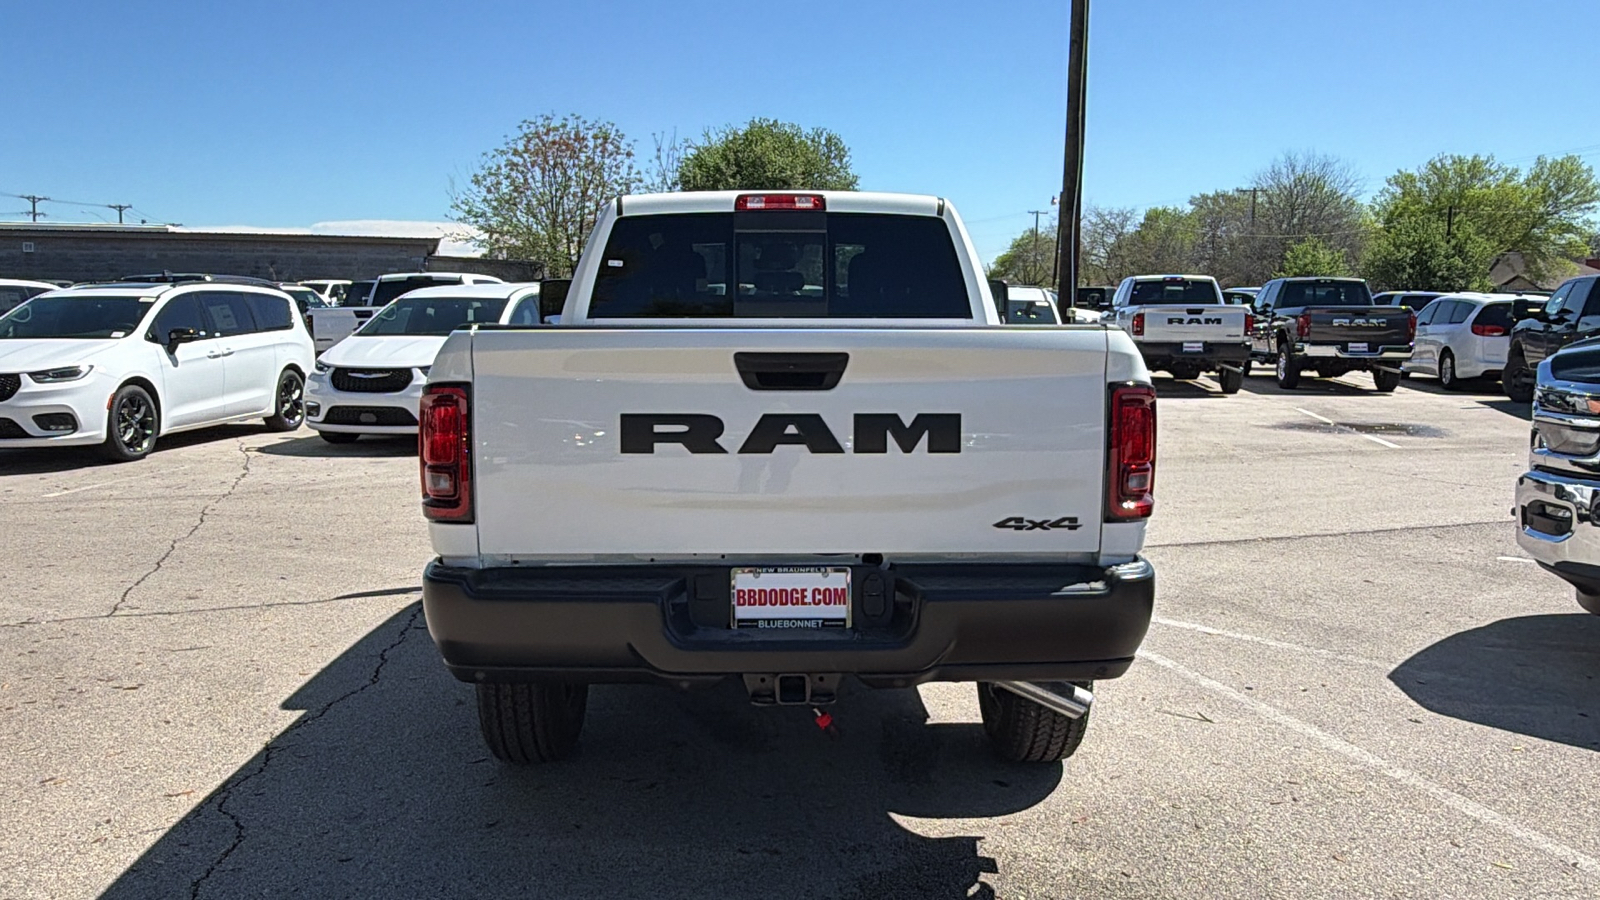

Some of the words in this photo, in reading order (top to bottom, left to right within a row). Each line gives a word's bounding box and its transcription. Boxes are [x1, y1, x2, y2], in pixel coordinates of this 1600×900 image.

[1167, 317, 1222, 325] RAM
[1332, 318, 1387, 327] RAM
[620, 413, 962, 454] RAM
[992, 516, 1083, 531] 4x4
[736, 587, 847, 606] BBDODGE.COM
[758, 619, 823, 628] BLUEBONNET
